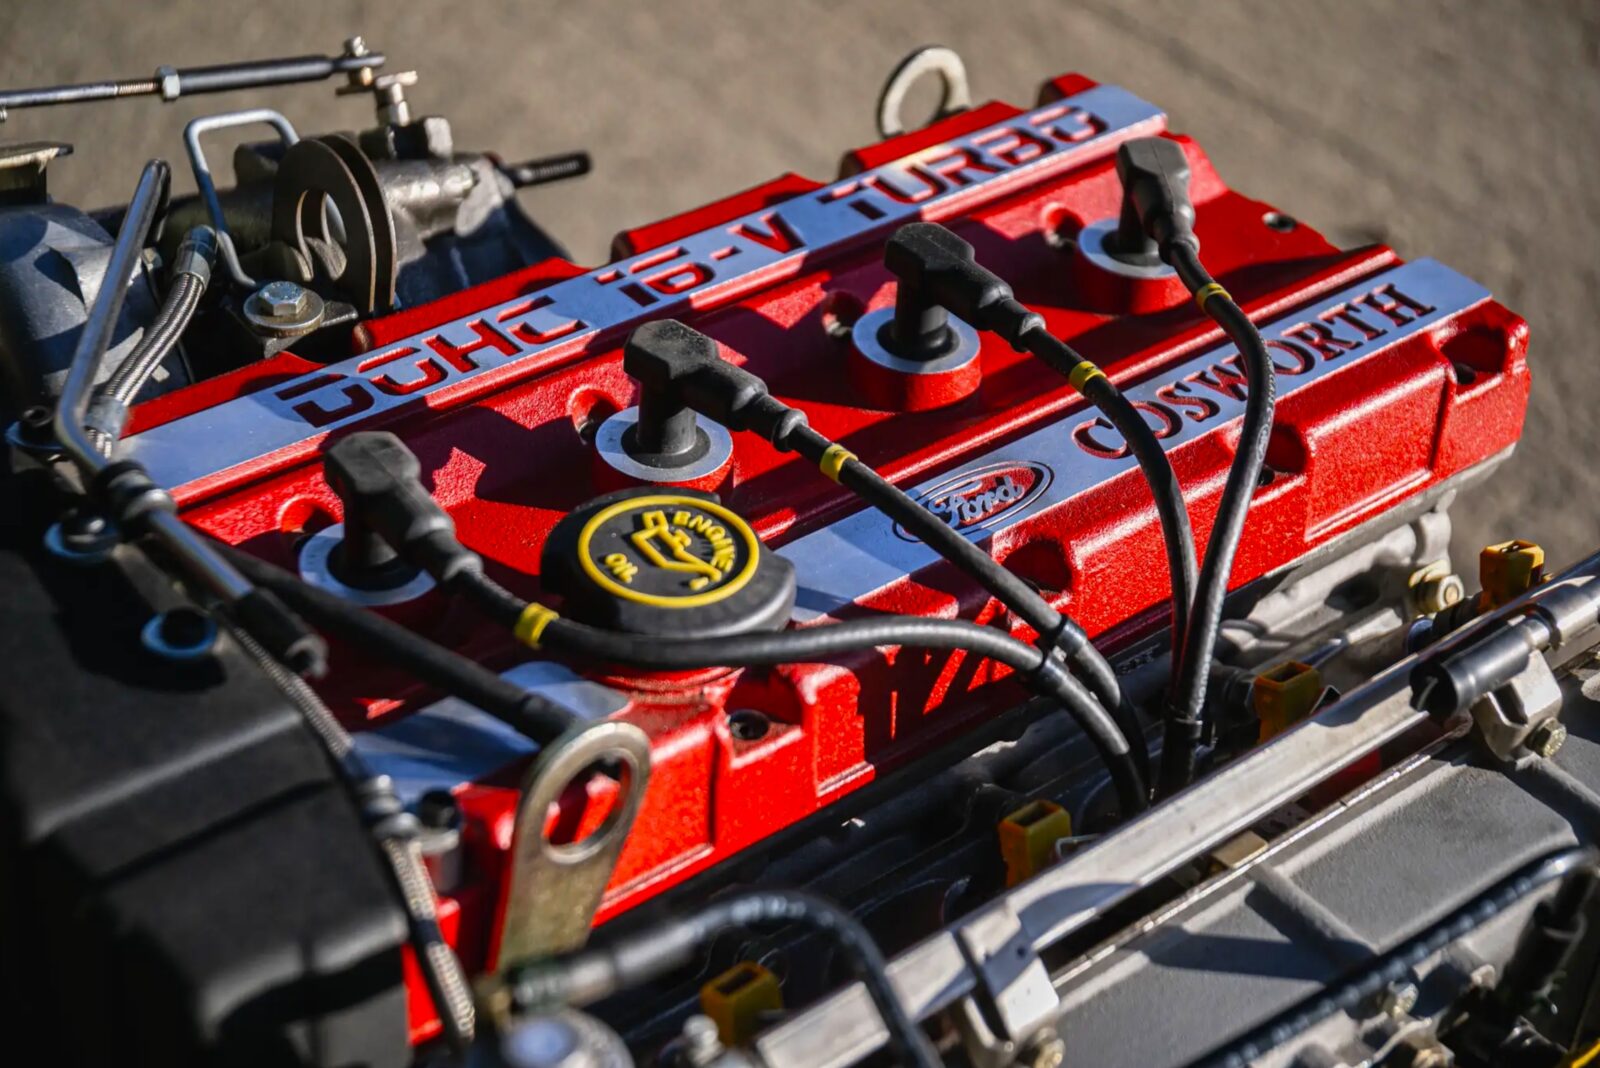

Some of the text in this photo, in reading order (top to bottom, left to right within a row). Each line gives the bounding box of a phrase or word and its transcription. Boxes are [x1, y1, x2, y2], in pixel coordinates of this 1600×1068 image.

[274, 106, 1109, 428] DOHC 16-V TURBO
[1071, 283, 1436, 459] COSWORTH
[604, 510, 736, 584] ENGINE OIL
[925, 475, 1025, 527] Ford
